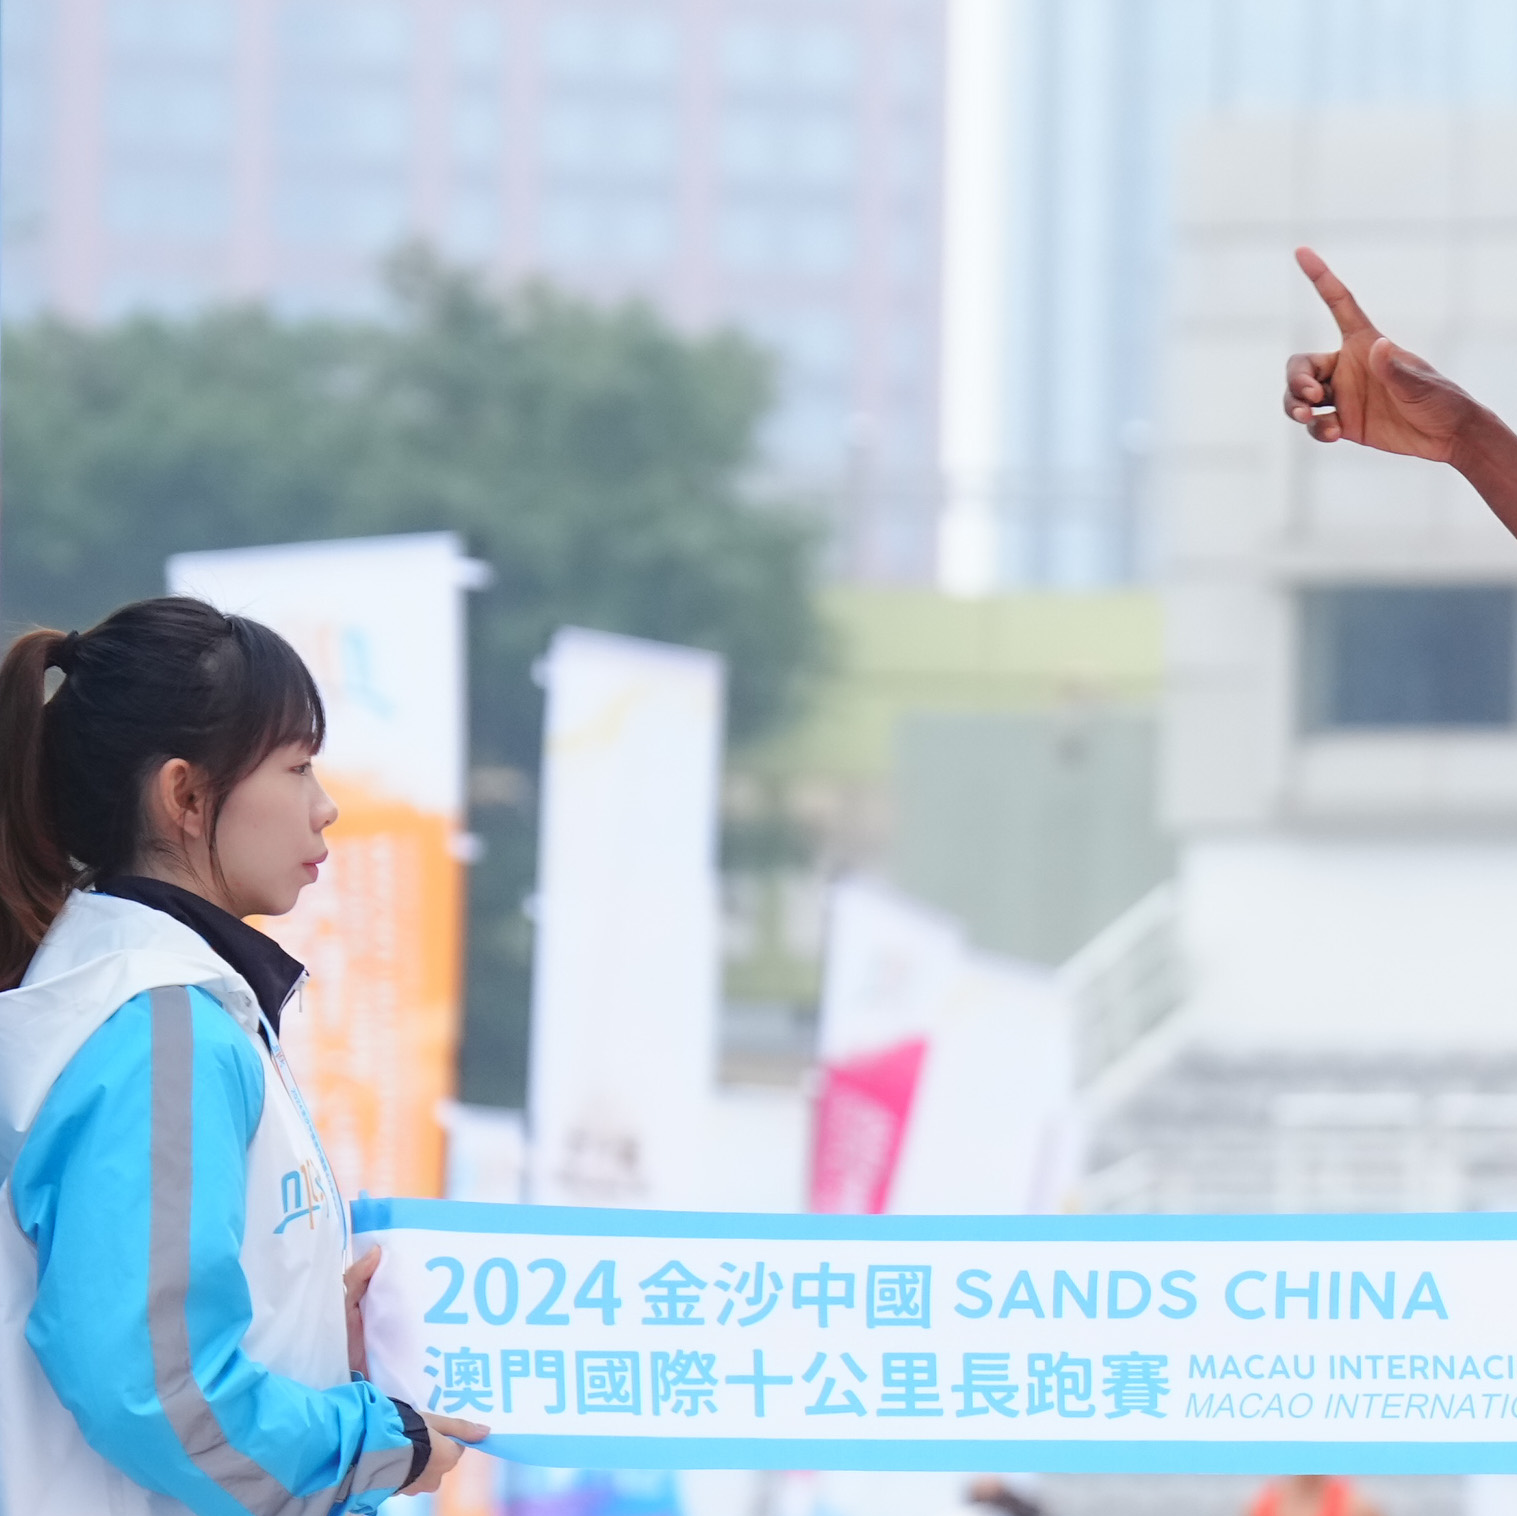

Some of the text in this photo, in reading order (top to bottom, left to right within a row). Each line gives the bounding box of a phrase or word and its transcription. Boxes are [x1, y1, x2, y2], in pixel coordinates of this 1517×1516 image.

[424, 1255, 1450, 1330] 2024 金沙中國 SANDS CHINA
[424, 1345, 1172, 1420] 澳門國際十公里長跑賽
[1188, 1353, 1316, 1381] MACAU
[1185, 1392, 1314, 1419] MACAO
